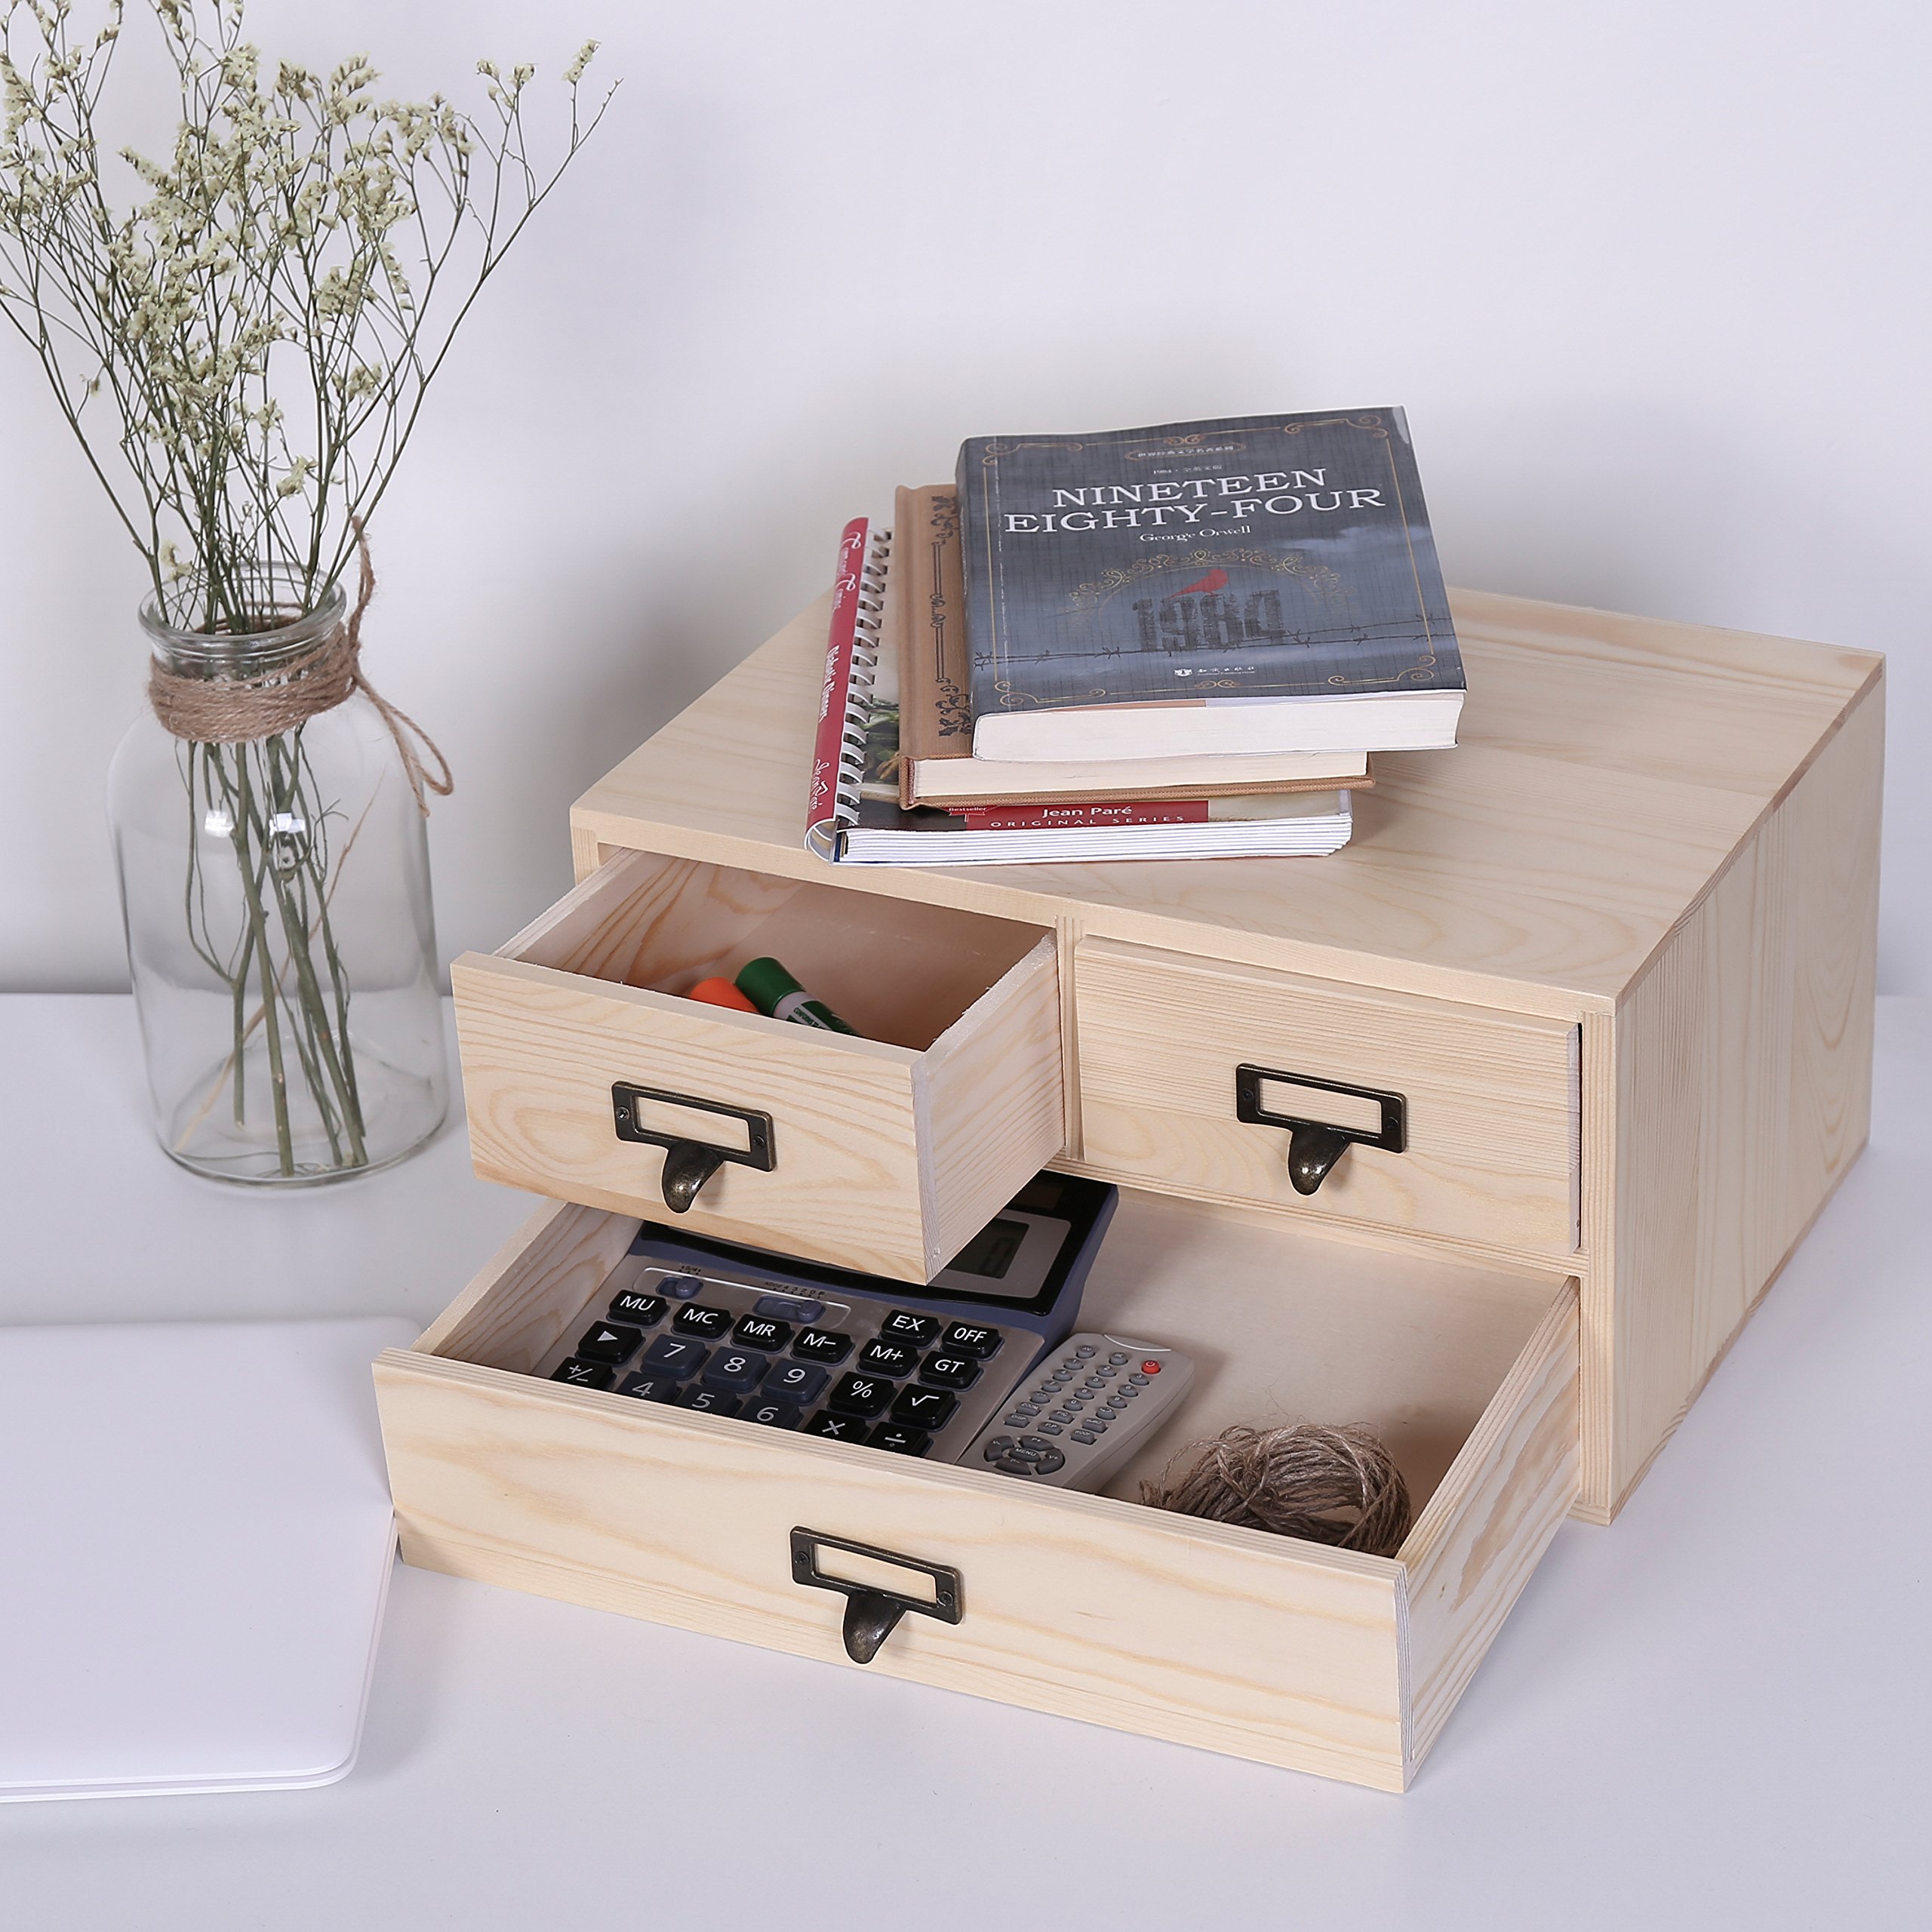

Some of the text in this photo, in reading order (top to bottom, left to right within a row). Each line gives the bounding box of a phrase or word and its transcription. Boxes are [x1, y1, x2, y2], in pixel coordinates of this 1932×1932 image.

[1052, 467, 1327, 508] NINETEEN
[1004, 488, 1386, 533] EIGHTY-FOUR
[1140, 525, 1251, 543] George Orwell
[1041, 806, 1133, 819] Jean Paré
[990, 816, 1185, 827] ORIGINAL SERIES
[620, 1295, 656, 1311] MU
[683, 1308, 718, 1324] MC
[892, 1315, 926, 1331] EX
[743, 1321, 776, 1337] MR
[954, 1327, 987, 1343] OFF
[663, 1343, 686, 1358] 7
[869, 1345, 903, 1361] M+
[724, 1356, 746, 1372] 8
[934, 1359, 965, 1374] GT
[783, 1368, 806, 1383] 9
[632, 1381, 654, 1396] 4
[851, 1380, 874, 1398] %
[691, 1392, 715, 1408] 5
[1021, 1402, 1039, 1411] ZOOM
[756, 1406, 779, 1422] 6
[1015, 1447, 1037, 1457] MENU
